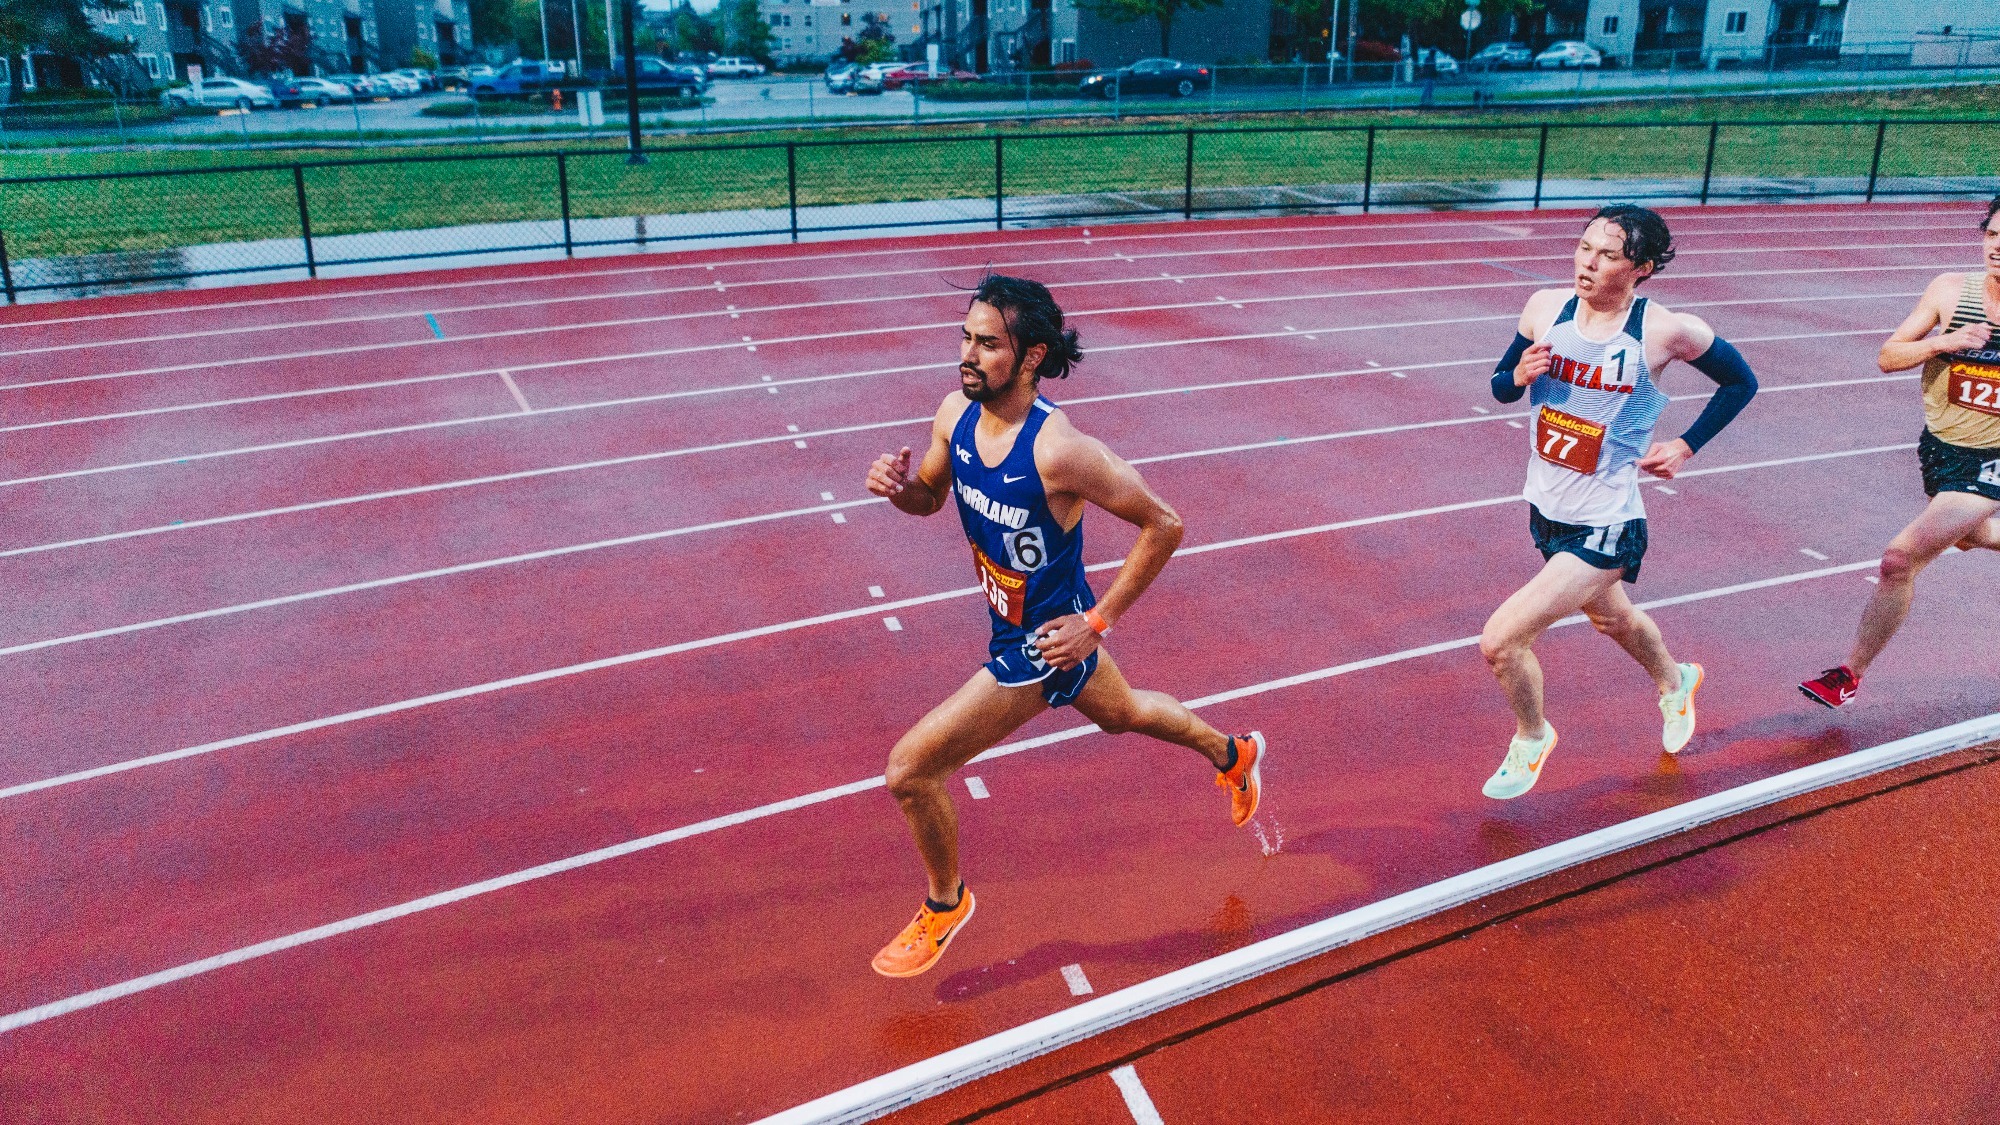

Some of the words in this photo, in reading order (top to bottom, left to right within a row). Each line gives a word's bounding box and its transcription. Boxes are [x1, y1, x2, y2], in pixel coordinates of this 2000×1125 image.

[1549, 354, 1633, 394] ONZA
[1611, 348, 1626, 382] 1
[1543, 429, 1578, 460] 77
[1014, 531, 1042, 568] 6
[981, 565, 1009, 617] 136
